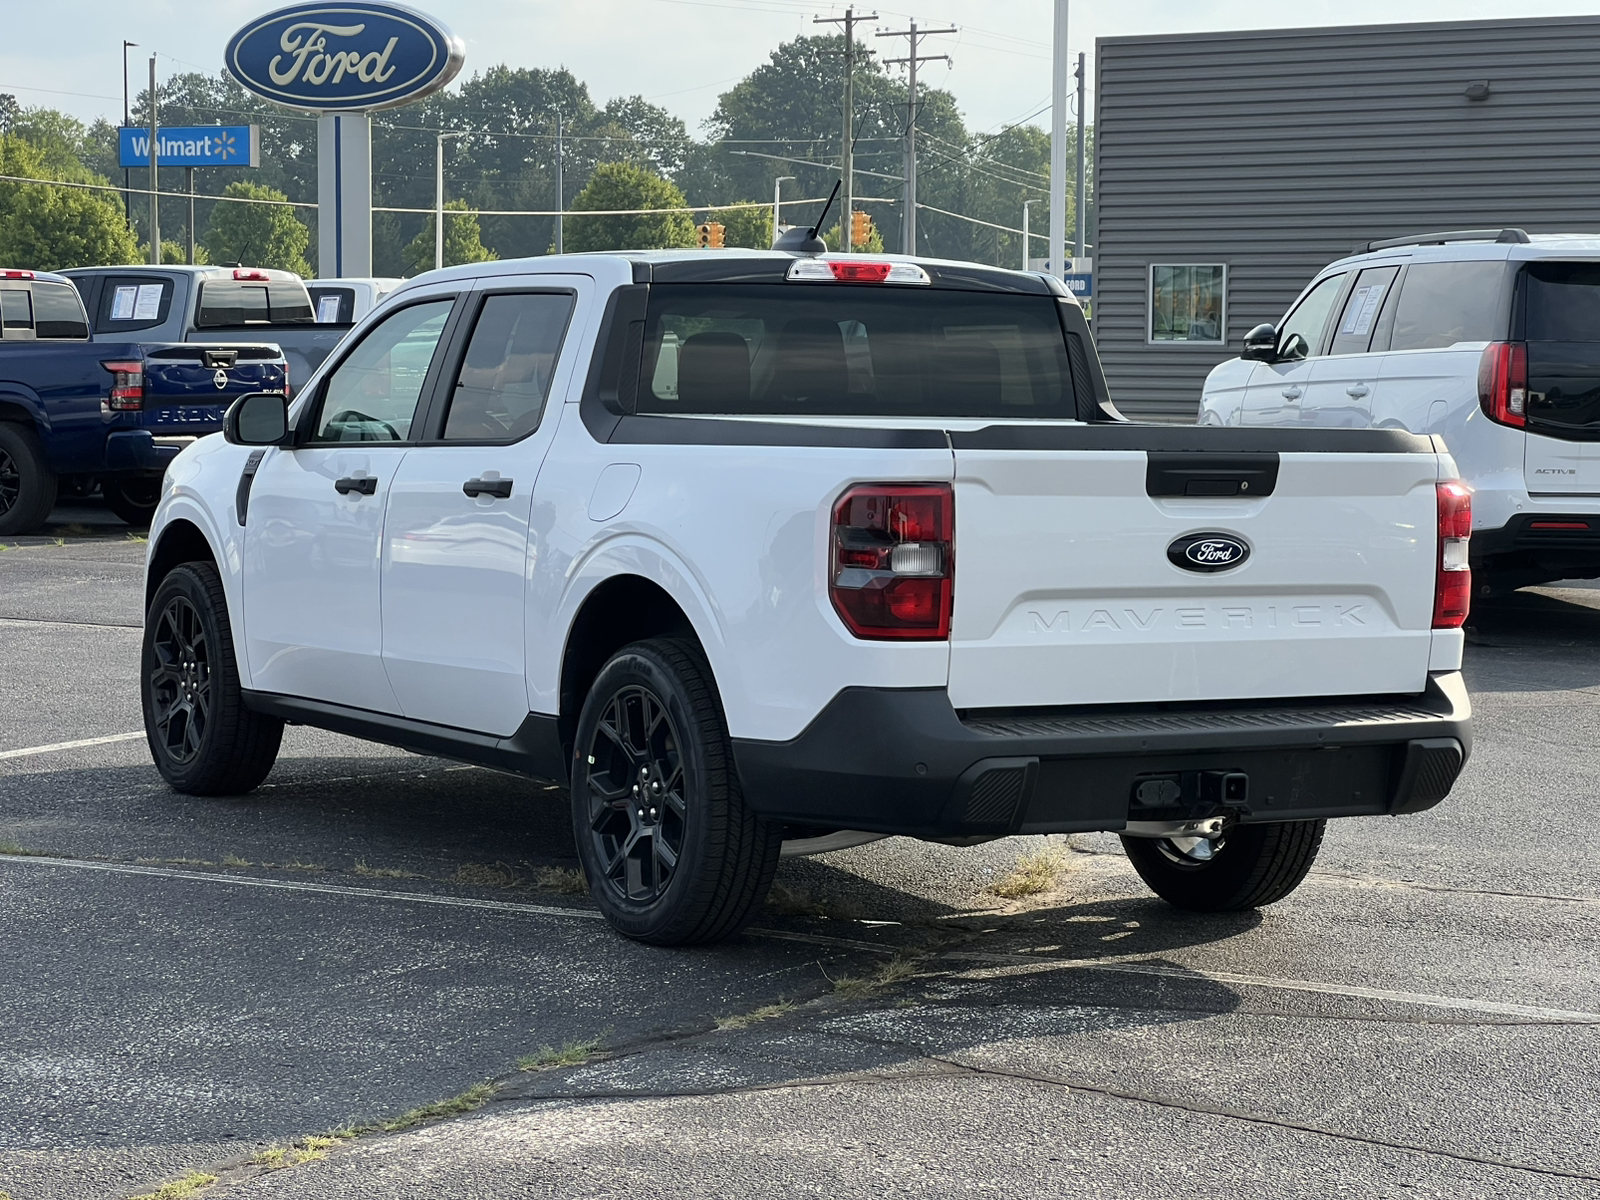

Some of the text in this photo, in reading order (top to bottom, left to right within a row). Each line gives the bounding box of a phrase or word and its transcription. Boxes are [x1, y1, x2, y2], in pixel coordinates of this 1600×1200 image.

[268, 22, 399, 86] Ford
[1066, 280, 1085, 291] FORD
[1197, 543, 1233, 561] Ford
[1028, 604, 1366, 634] MAVERICK
